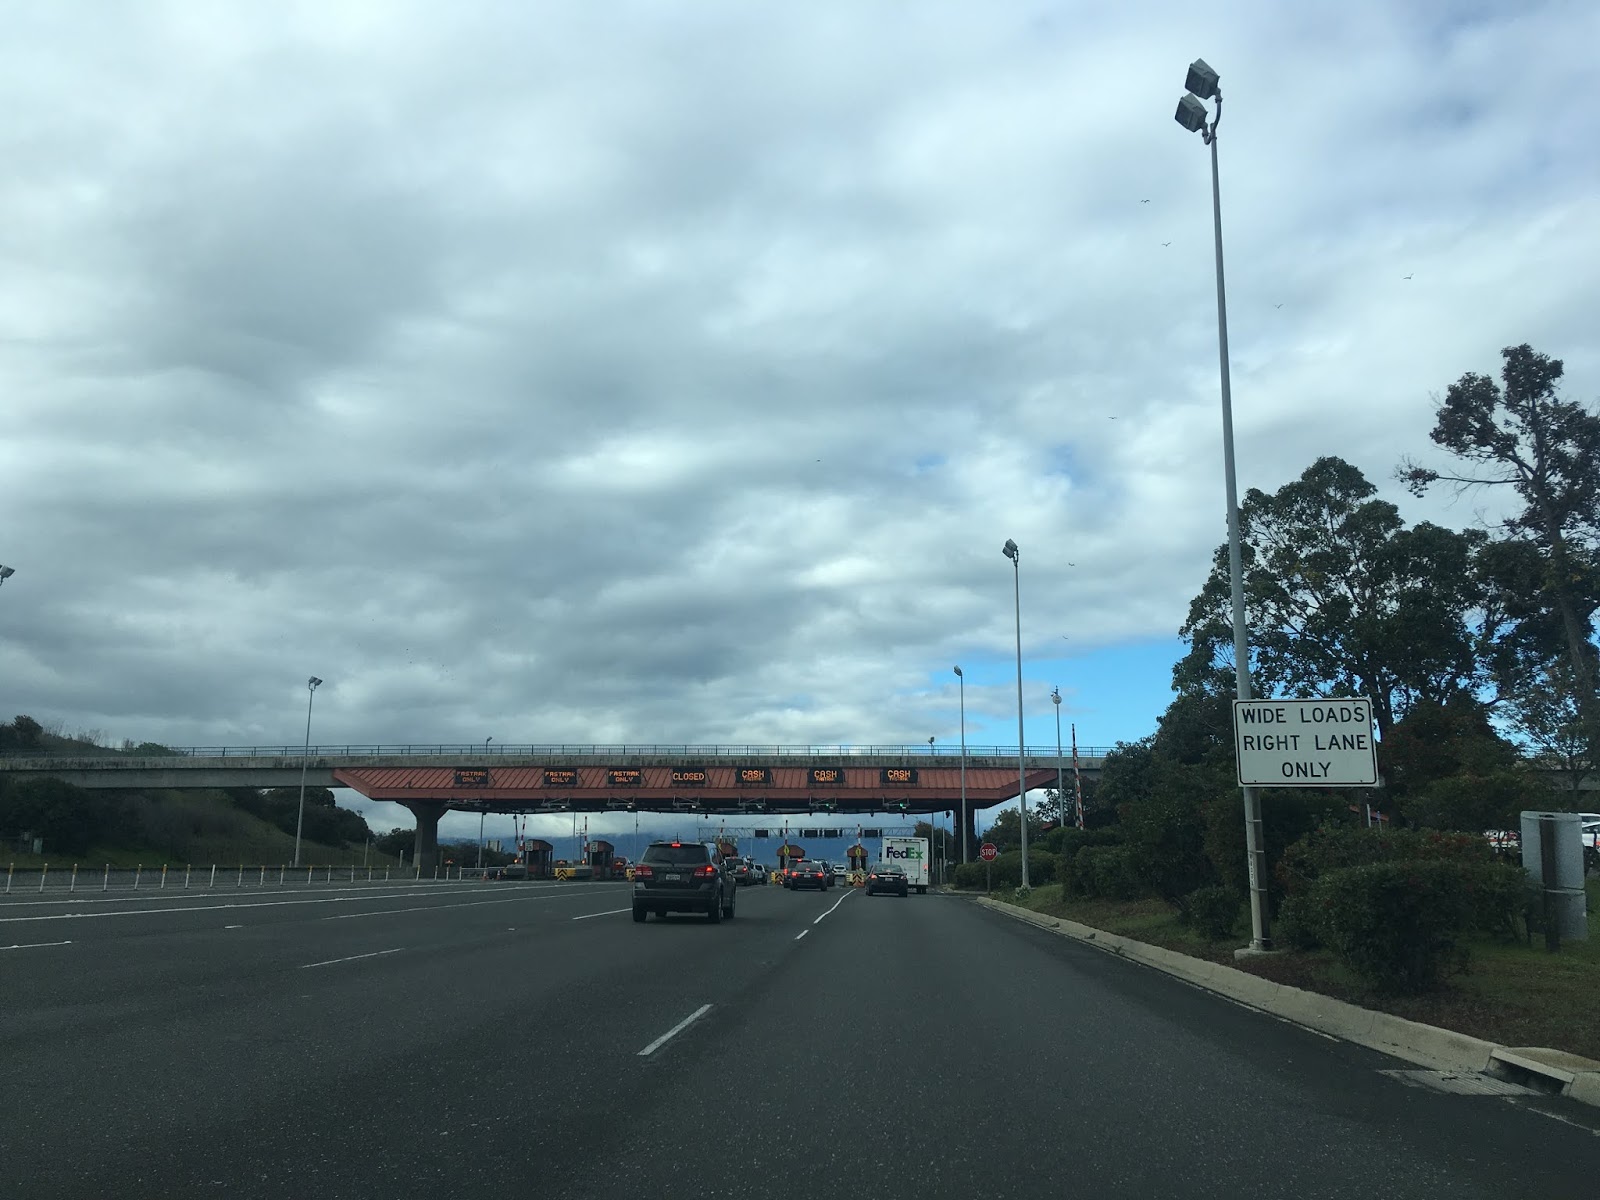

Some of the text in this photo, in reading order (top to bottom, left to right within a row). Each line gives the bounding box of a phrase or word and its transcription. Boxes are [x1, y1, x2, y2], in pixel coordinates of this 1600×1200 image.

[1242, 707, 1365, 724] WIDE LOADS
[1243, 734, 1368, 751] RIGHT LANE
[741, 770, 765, 778] CASH
[814, 770, 838, 778] CASH
[887, 770, 911, 778] CASH
[1282, 762, 1332, 778] ONLY
[672, 772, 705, 781] CLOSED
[886, 846, 924, 859] FedEx
[981, 848, 996, 856] STOP
